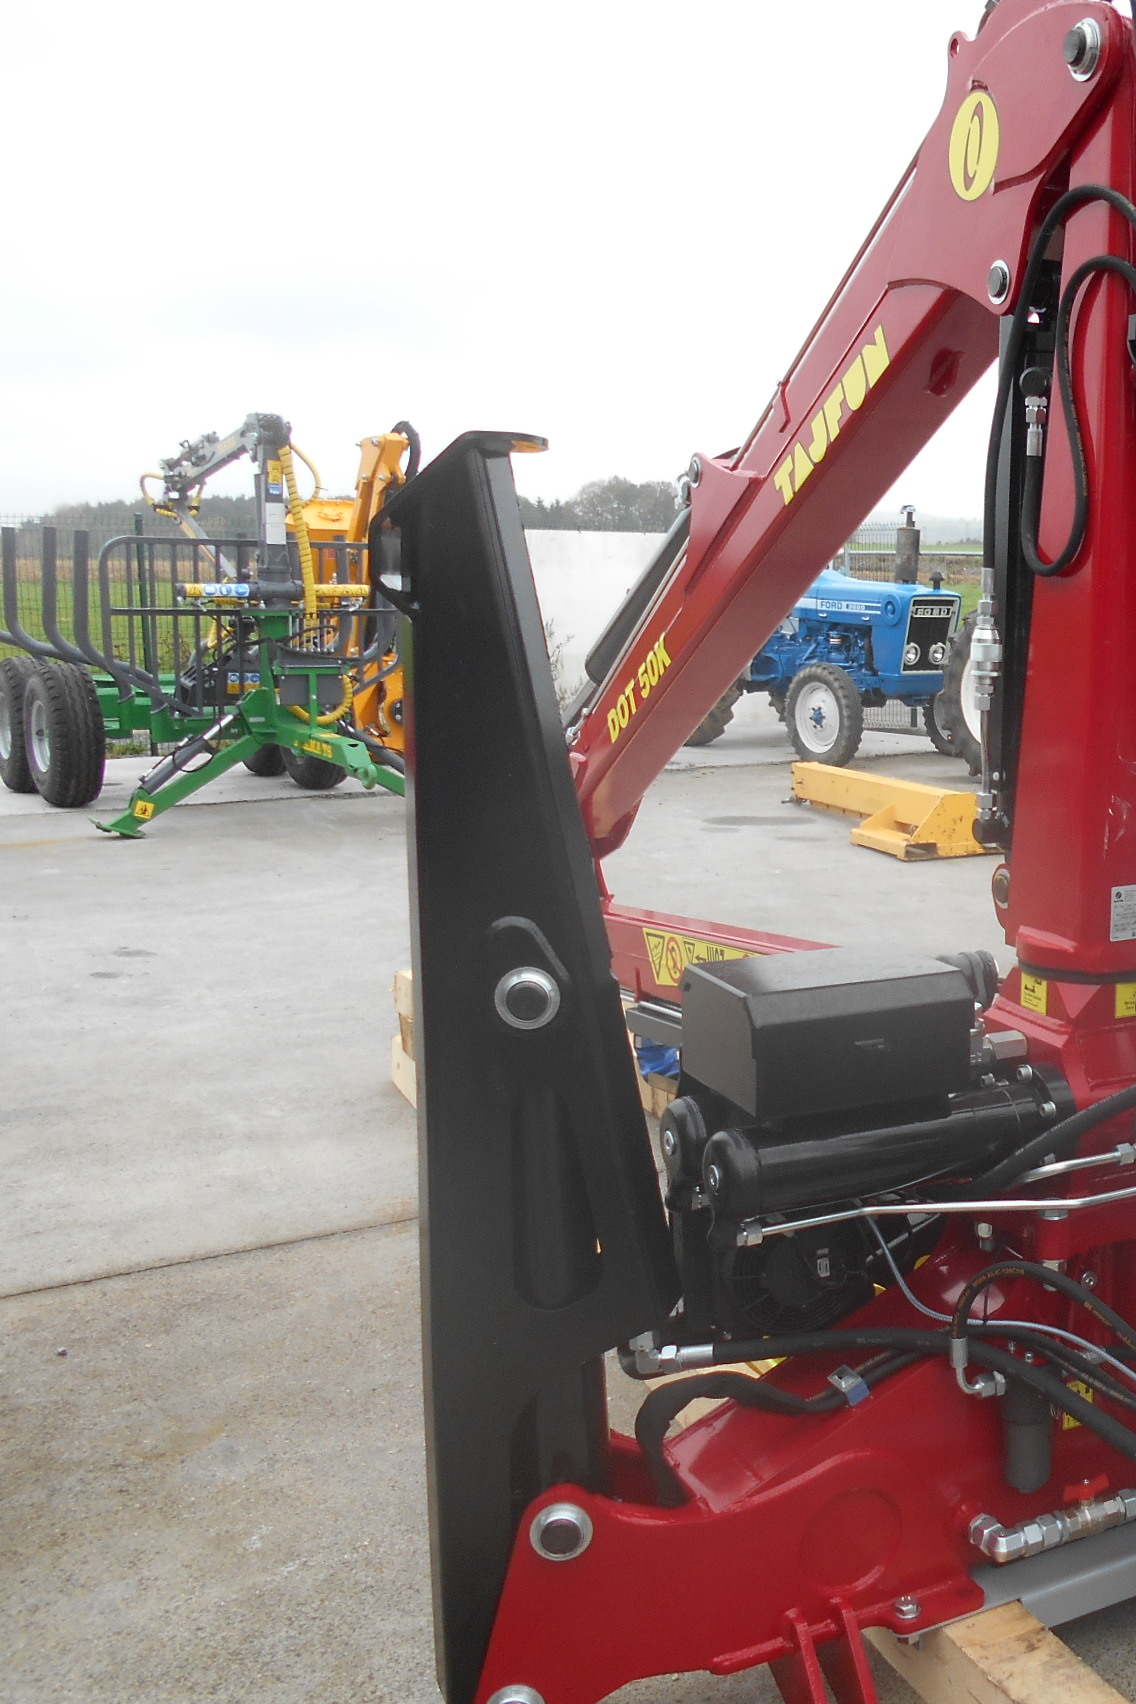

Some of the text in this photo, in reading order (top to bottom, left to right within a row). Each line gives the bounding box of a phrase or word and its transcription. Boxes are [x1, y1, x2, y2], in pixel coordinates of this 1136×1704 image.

[774, 325, 890, 505] TAJFUN
[821, 601, 842, 609] FORD
[607, 632, 671, 743] DOT 50K
